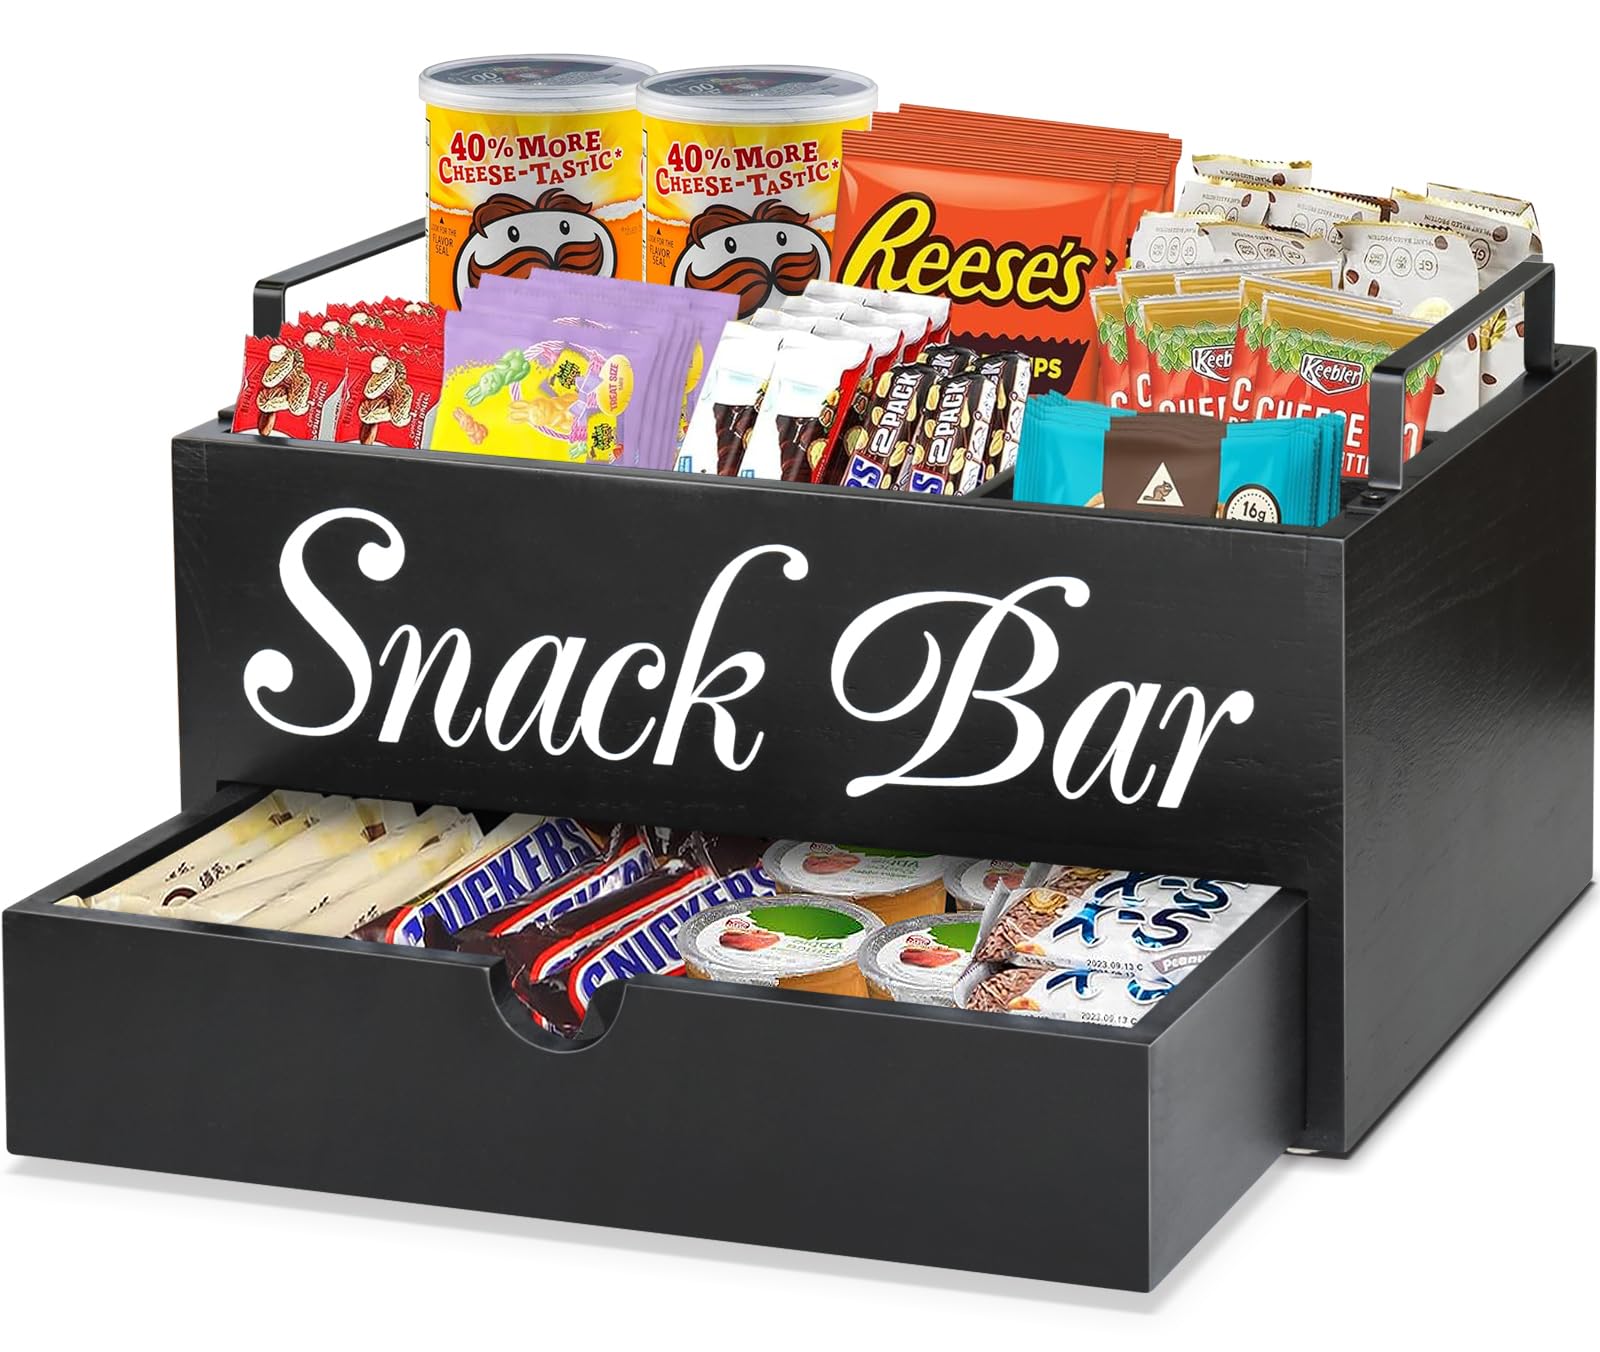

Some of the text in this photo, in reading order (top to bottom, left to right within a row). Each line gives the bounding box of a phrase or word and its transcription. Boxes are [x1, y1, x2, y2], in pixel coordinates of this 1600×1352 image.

[450, 130, 601, 162] 40% MORE
[667, 141, 818, 172] 40% MORE
[432, 233, 453, 247] FLAVOR
[436, 245, 449, 257] SEAL
[650, 244, 671, 259] FLAVOR
[842, 197, 1092, 307] Reese's
[652, 255, 666, 268] SEAL
[1418, 259, 1433, 271] GF
[609, 363, 619, 382] SIZE
[1029, 357, 1062, 379] PS
[1303, 355, 1364, 387] Keebler
[1243, 501, 1266, 522] 16g
[243, 507, 1255, 809] Snack Bar
[1087, 959, 1144, 971] 2023.09.13 C
[1130, 1017, 1138, 1025] C
